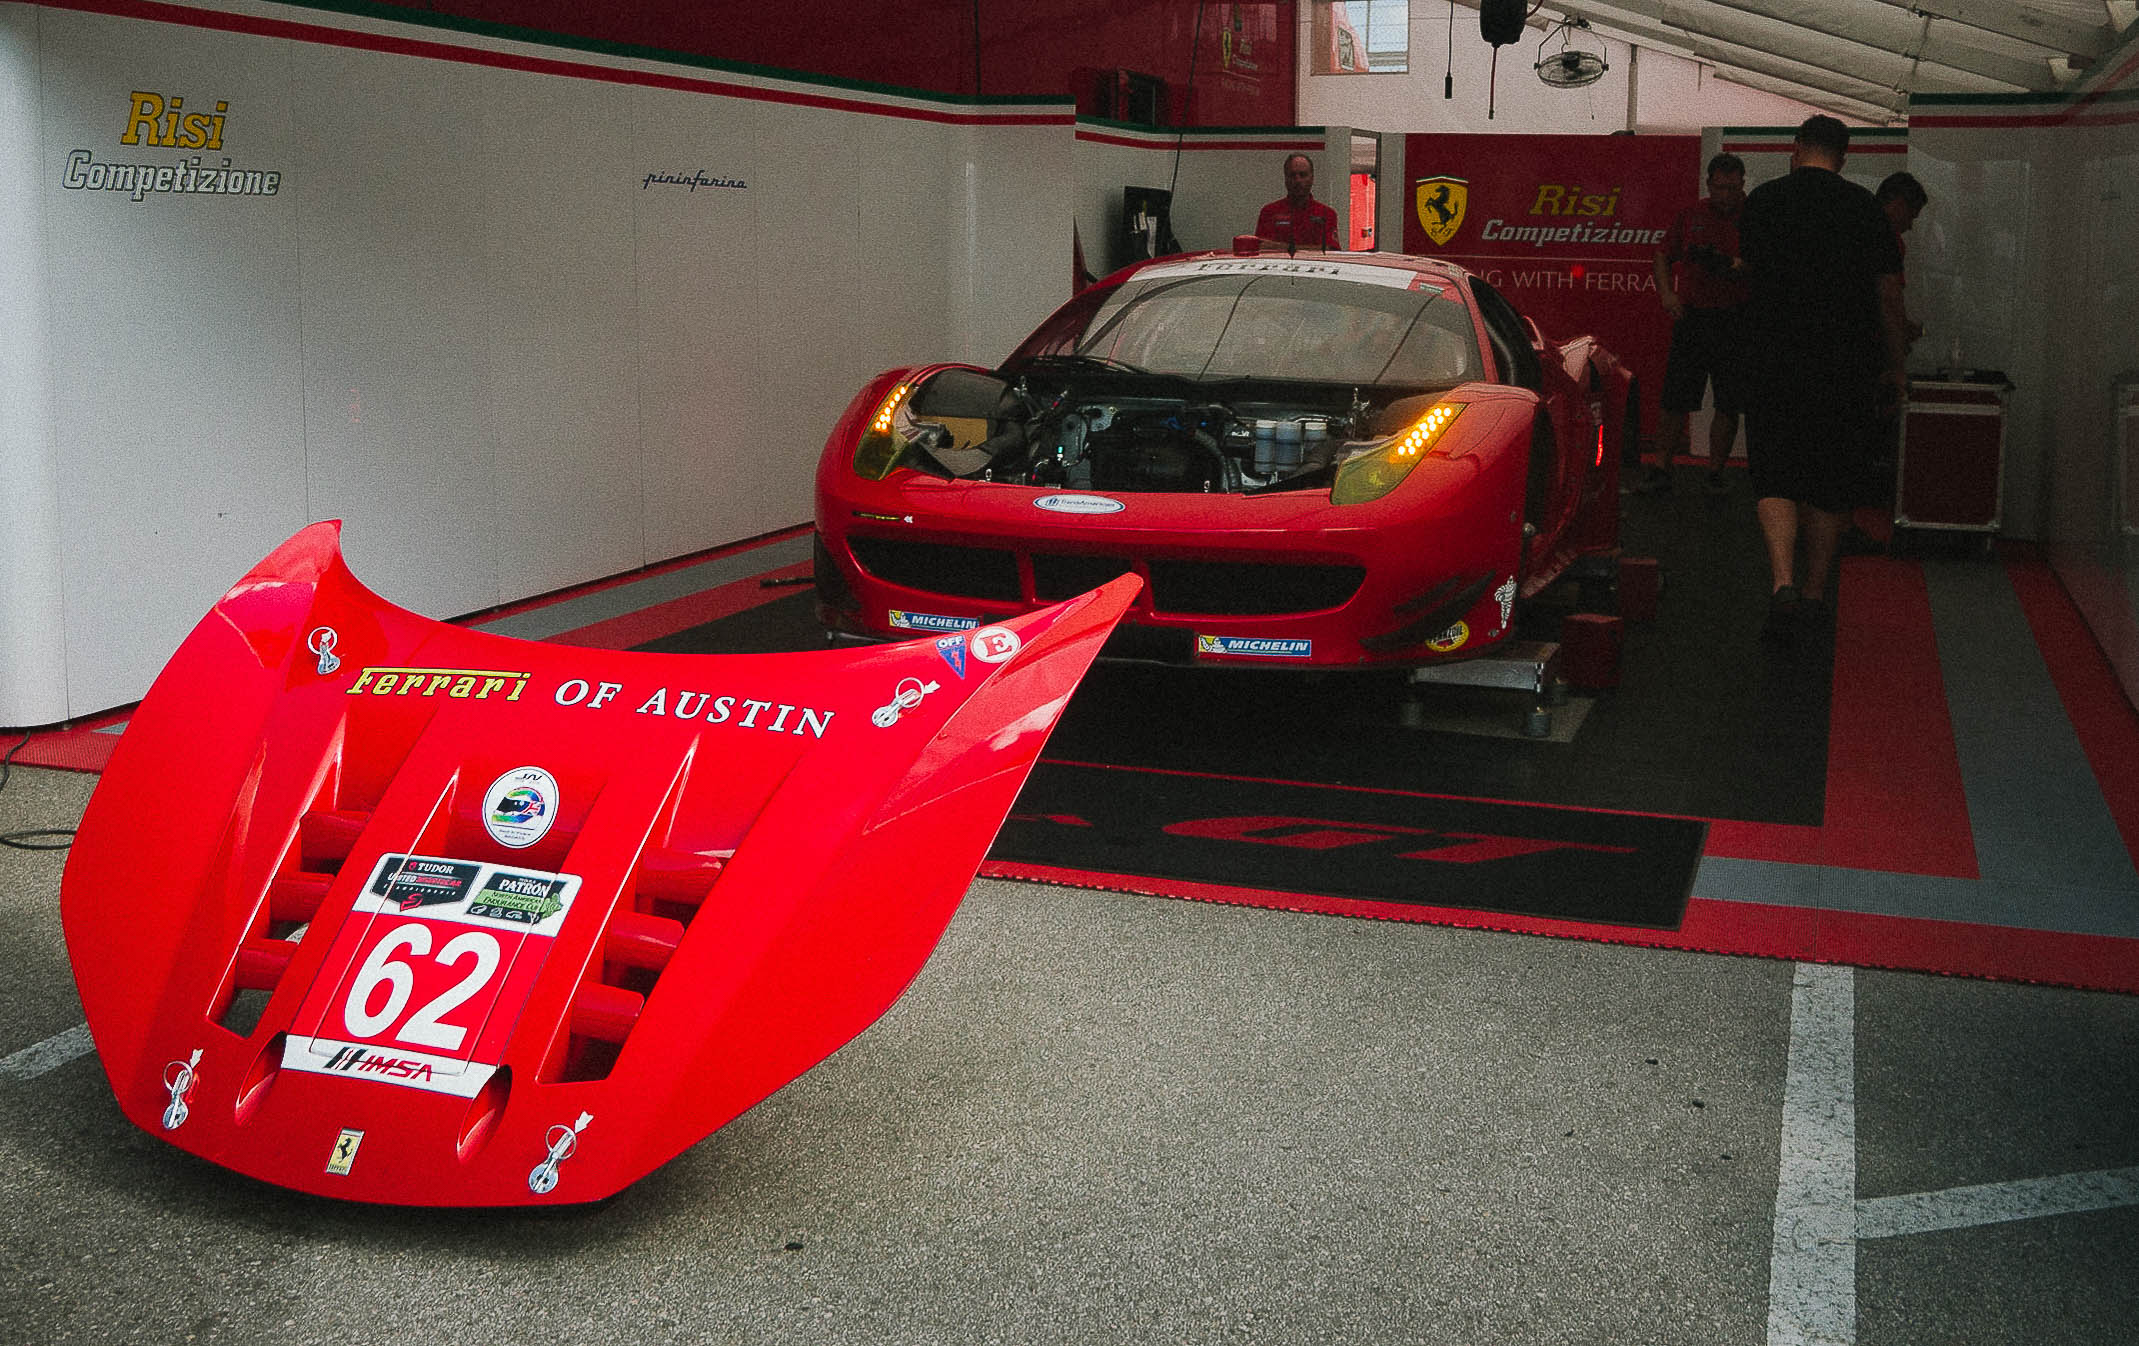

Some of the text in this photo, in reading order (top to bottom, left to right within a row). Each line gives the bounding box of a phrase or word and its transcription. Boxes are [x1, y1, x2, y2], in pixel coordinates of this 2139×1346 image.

[120, 91, 228, 150] Risi
[63, 149, 281, 202] Competizione
[642, 169, 747, 192] pininfarina
[1528, 184, 1621, 216] Risi
[1481, 219, 1667, 247] Competizione
[1512, 270, 1574, 289] WITH
[1585, 272, 1679, 292] FERRAI
[911, 615, 977, 629] MICHELIN
[937, 635, 965, 649] OFF
[979, 632, 1013, 657] E
[1228, 640, 1308, 651] MICHELIN
[345, 667, 835, 739] Ferrari OF AUSTIN
[418, 862, 455, 874] TUDOR
[344, 923, 500, 1051] 62
[357, 1055, 432, 1082] IMSA
